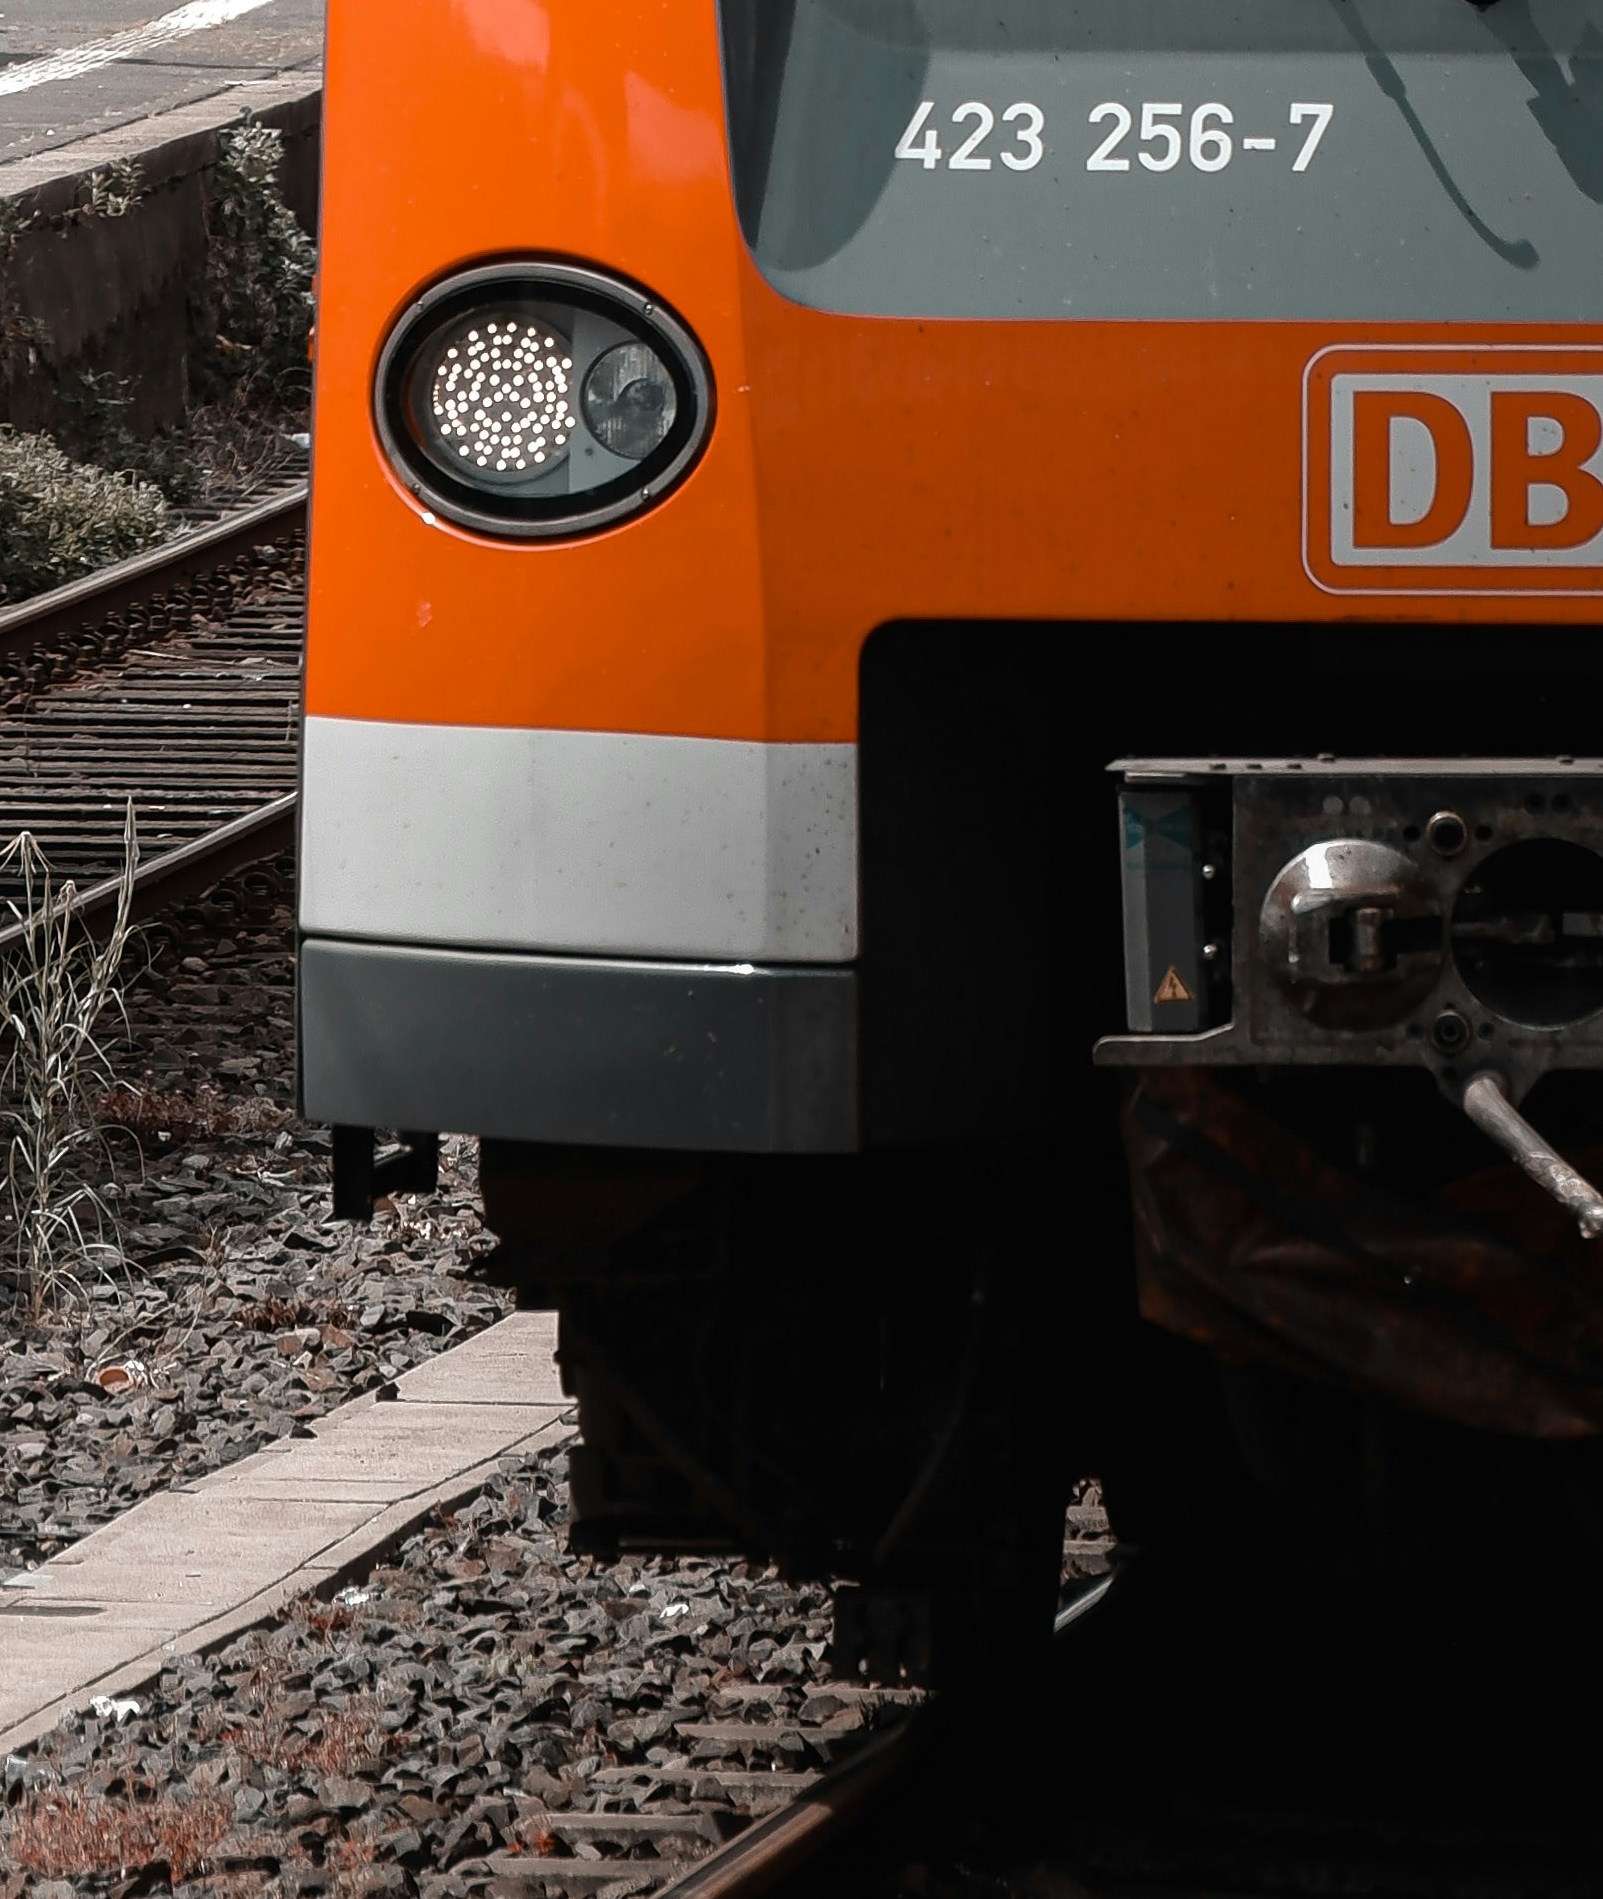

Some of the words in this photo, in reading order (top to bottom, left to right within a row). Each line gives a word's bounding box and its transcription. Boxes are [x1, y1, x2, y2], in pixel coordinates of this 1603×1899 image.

[892, 101, 1046, 172] 423
[1085, 101, 1336, 173] 256-7
[1351, 389, 1603, 552] DB
